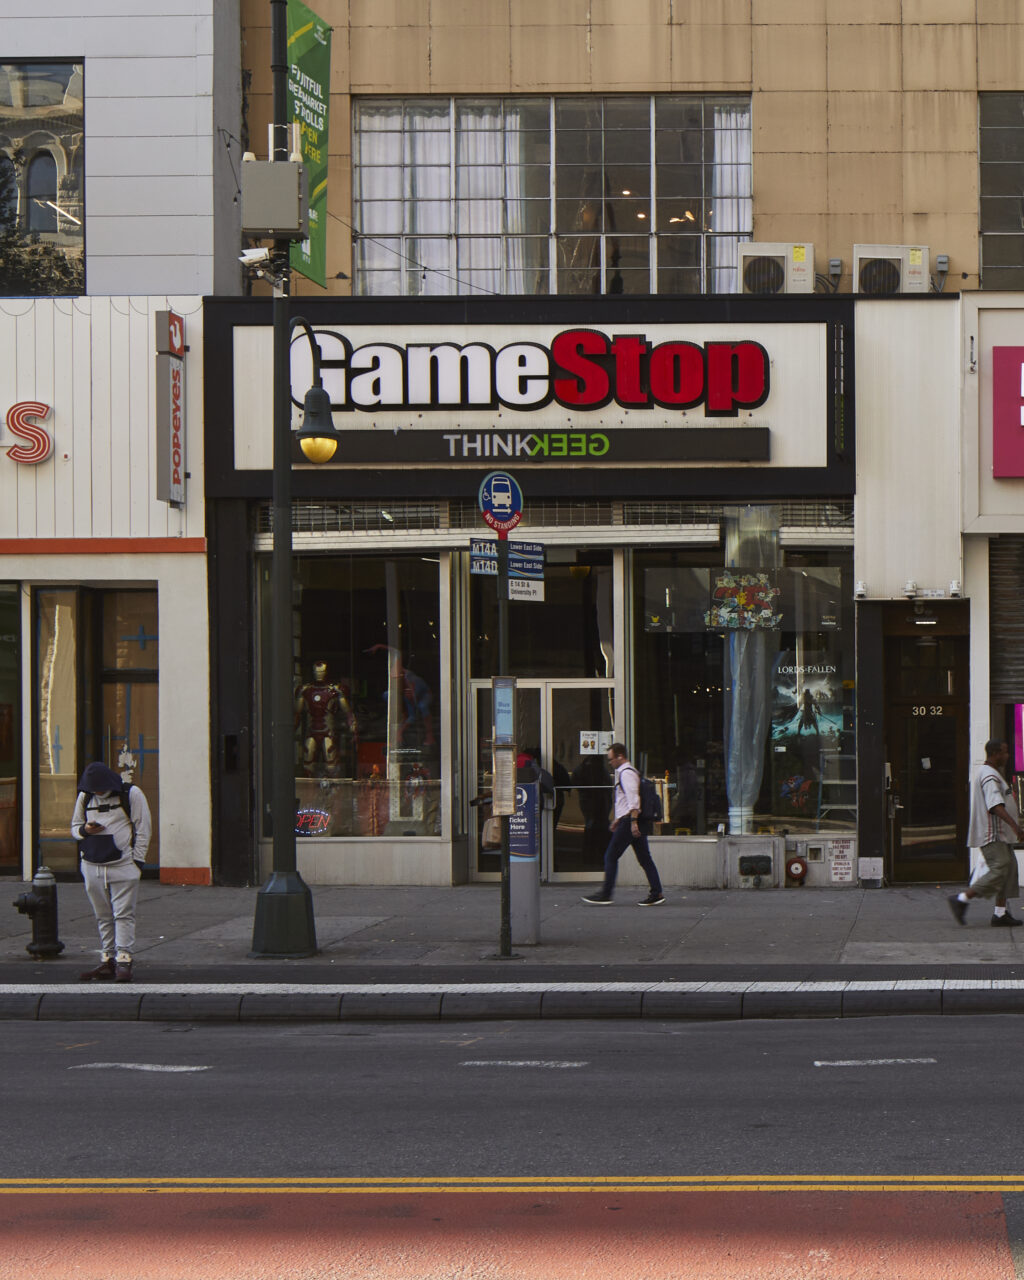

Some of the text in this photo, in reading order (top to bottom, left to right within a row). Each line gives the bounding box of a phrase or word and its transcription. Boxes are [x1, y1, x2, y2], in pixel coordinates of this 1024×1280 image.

[290, 328, 769, 417] GameStop
[485, 513, 520, 529] NO STANDING
[472, 542, 498, 556] M14A
[777, 666, 805, 674] LORDS
[807, 665, 836, 673] FALLEN
[912, 706, 943, 716] 30 32
